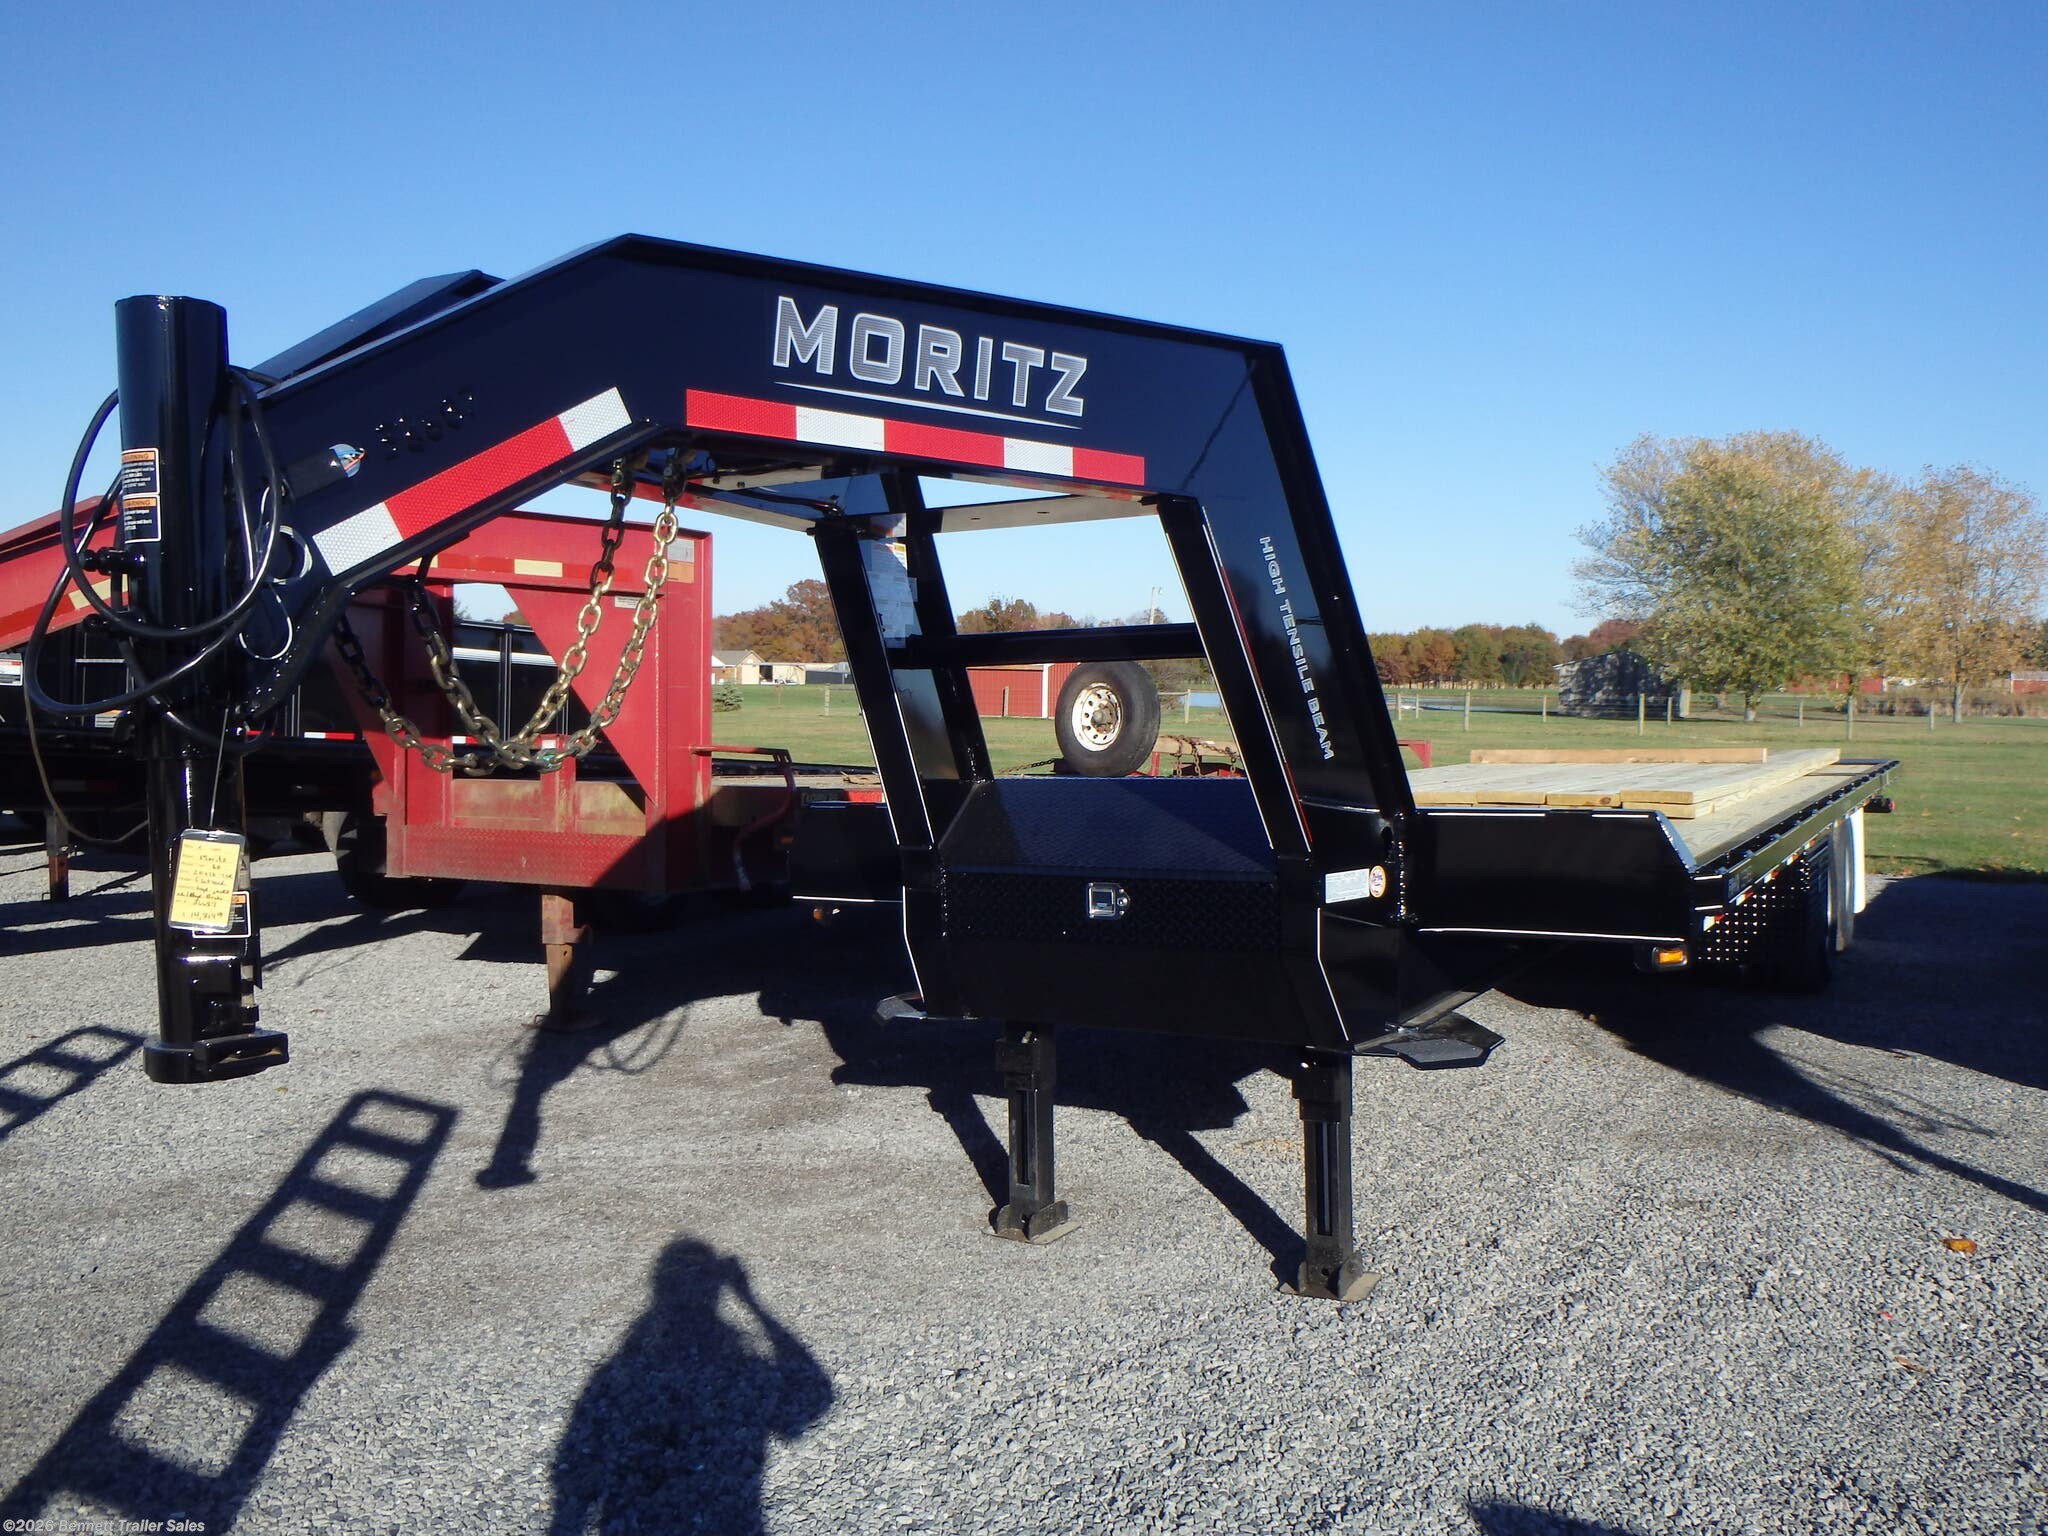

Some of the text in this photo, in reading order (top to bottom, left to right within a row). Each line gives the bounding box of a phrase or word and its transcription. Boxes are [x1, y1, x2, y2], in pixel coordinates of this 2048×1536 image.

[772, 295, 1088, 417] MORITZ
[1259, 536, 1335, 761] HIGH TENSILE BEAM
